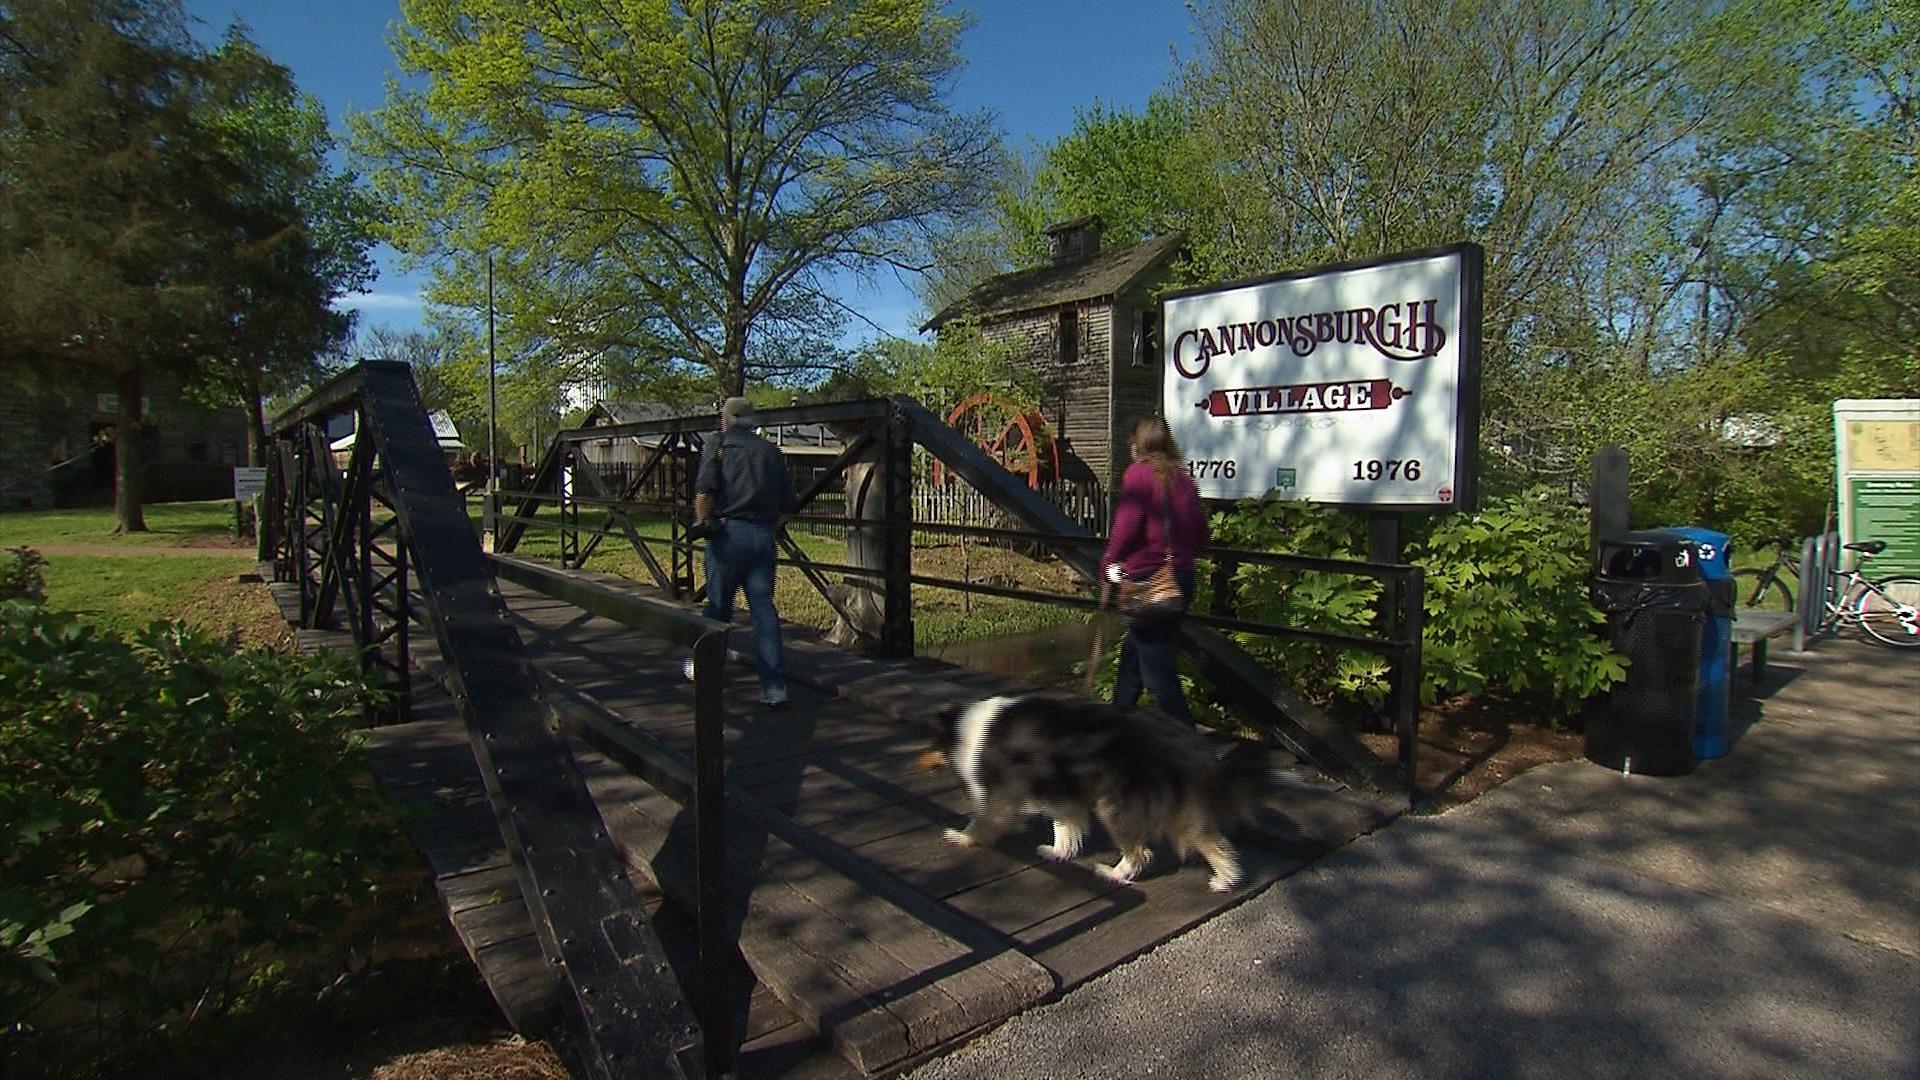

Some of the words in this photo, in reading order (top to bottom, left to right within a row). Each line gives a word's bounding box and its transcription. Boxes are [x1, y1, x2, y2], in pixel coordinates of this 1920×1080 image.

[1174, 299, 1446, 379] CANNONSBURGH
[1225, 382, 1372, 415] VILLAGE
[1187, 460, 1236, 479] 1776
[1353, 459, 1421, 481] 1976
